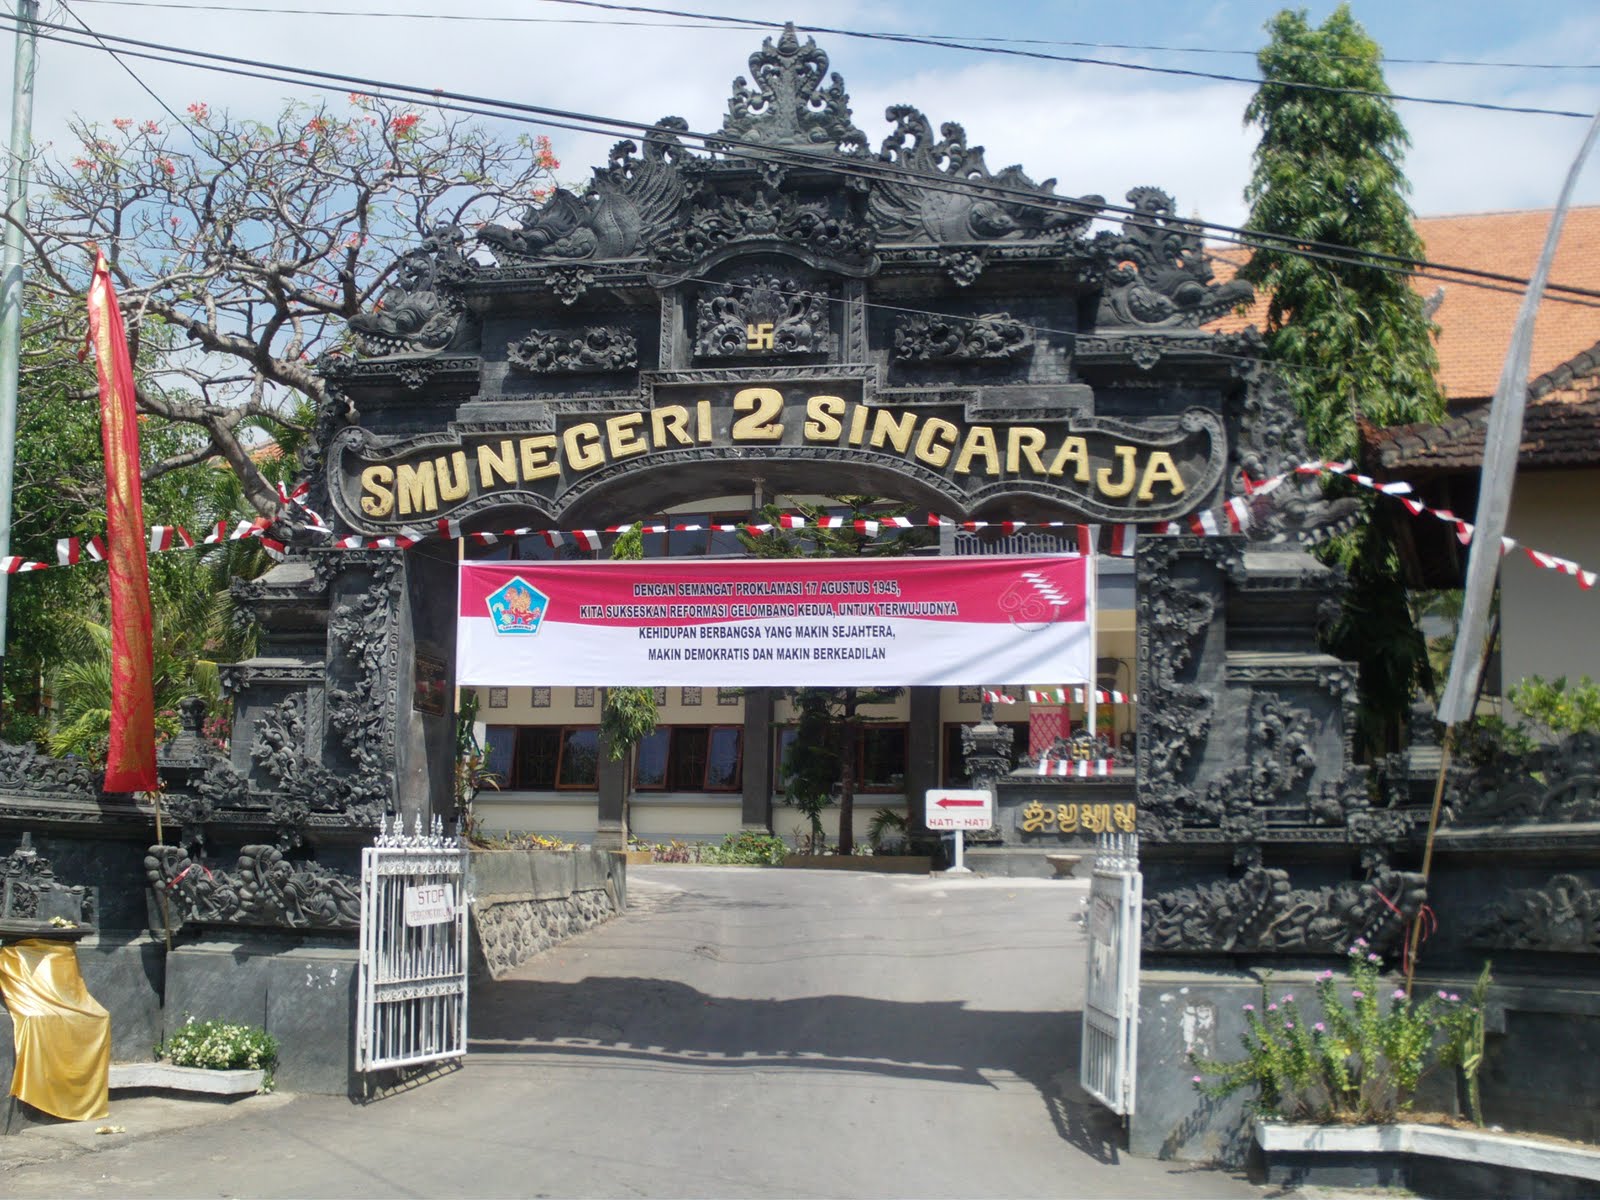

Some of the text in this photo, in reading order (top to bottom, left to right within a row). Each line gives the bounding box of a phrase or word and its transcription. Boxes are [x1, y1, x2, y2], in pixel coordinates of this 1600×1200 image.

[361, 387, 1186, 517] SMU NEGERI 2 SINGARAJA
[634, 580, 900, 597] DENGAN SEMANGAT PROKLAMASI 17 AGUSTUS 1945,
[580, 602, 958, 619] KITA SUKSESKAN REFORMASI GELOMBANG KEDUA, UNTUK TERWUJUDNYA
[639, 625, 896, 640] KEHIDUPAN BERBANGSA YANG MAKIN SEJAHTERA,
[648, 647, 886, 661] MAKIN DEMOKRATIS DAN MAKIN BERKEADILAN
[929, 818, 954, 827] HATI
[964, 818, 990, 827] HATI
[418, 889, 445, 906] STOP
